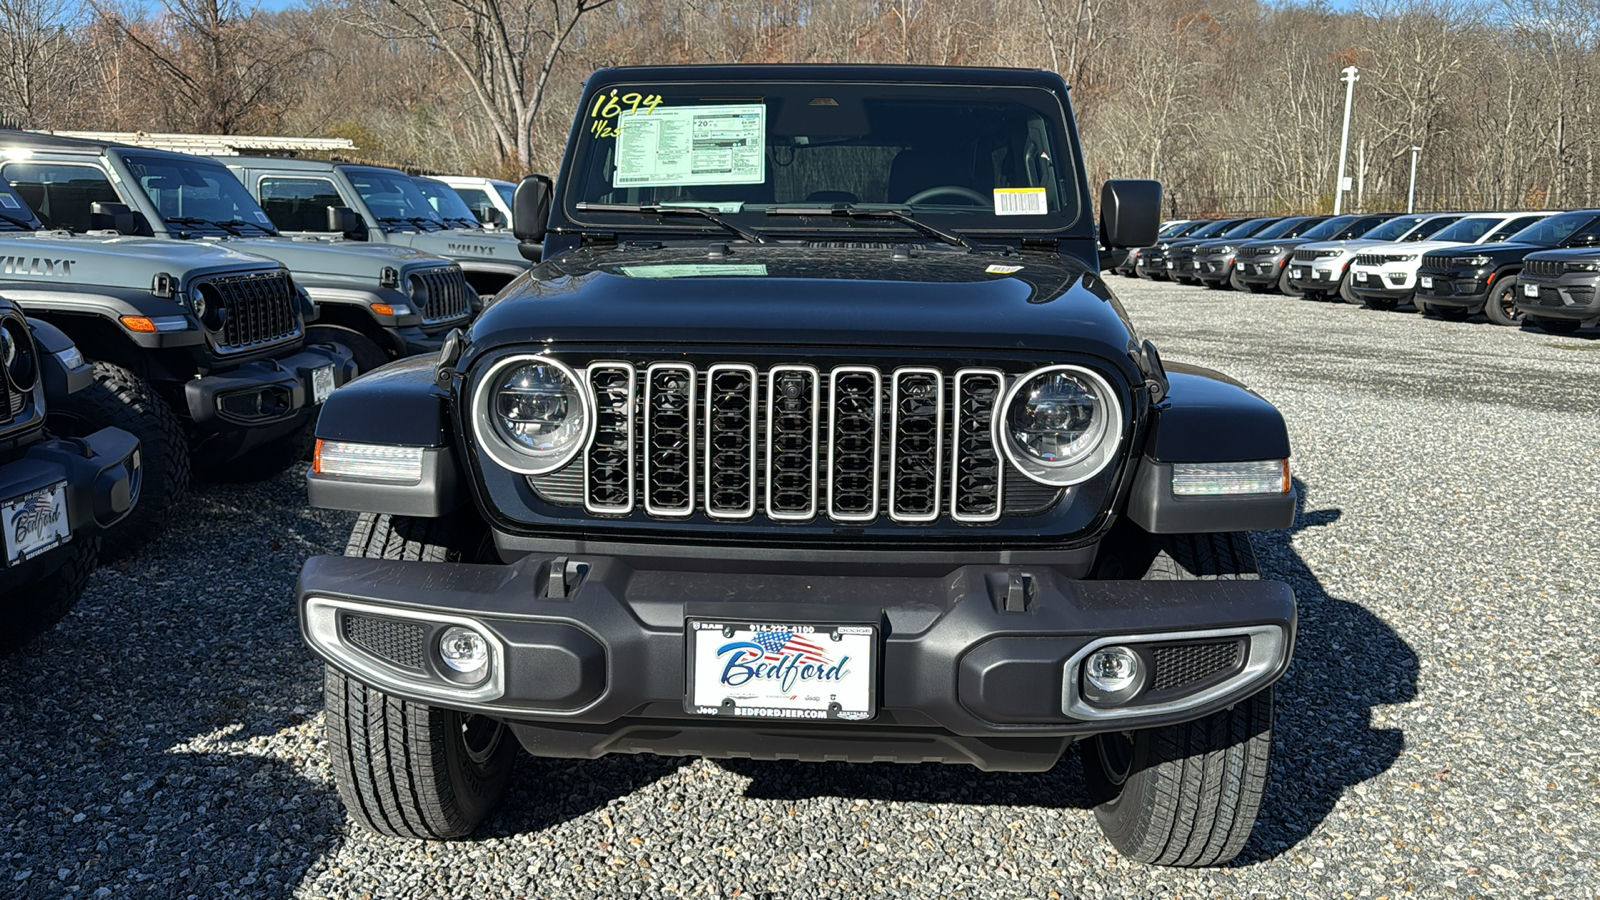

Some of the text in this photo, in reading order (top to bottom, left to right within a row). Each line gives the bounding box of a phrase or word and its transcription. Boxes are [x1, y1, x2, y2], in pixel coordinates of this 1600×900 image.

[591, 92, 663, 118] 1694
[448, 243, 495, 256] WILLYS
[11, 503, 61, 543] Bedford
[717, 641, 850, 693] Bedford
[696, 706, 718, 715] Jeep
[734, 708, 828, 719] BEDFORDJEEP.COM
